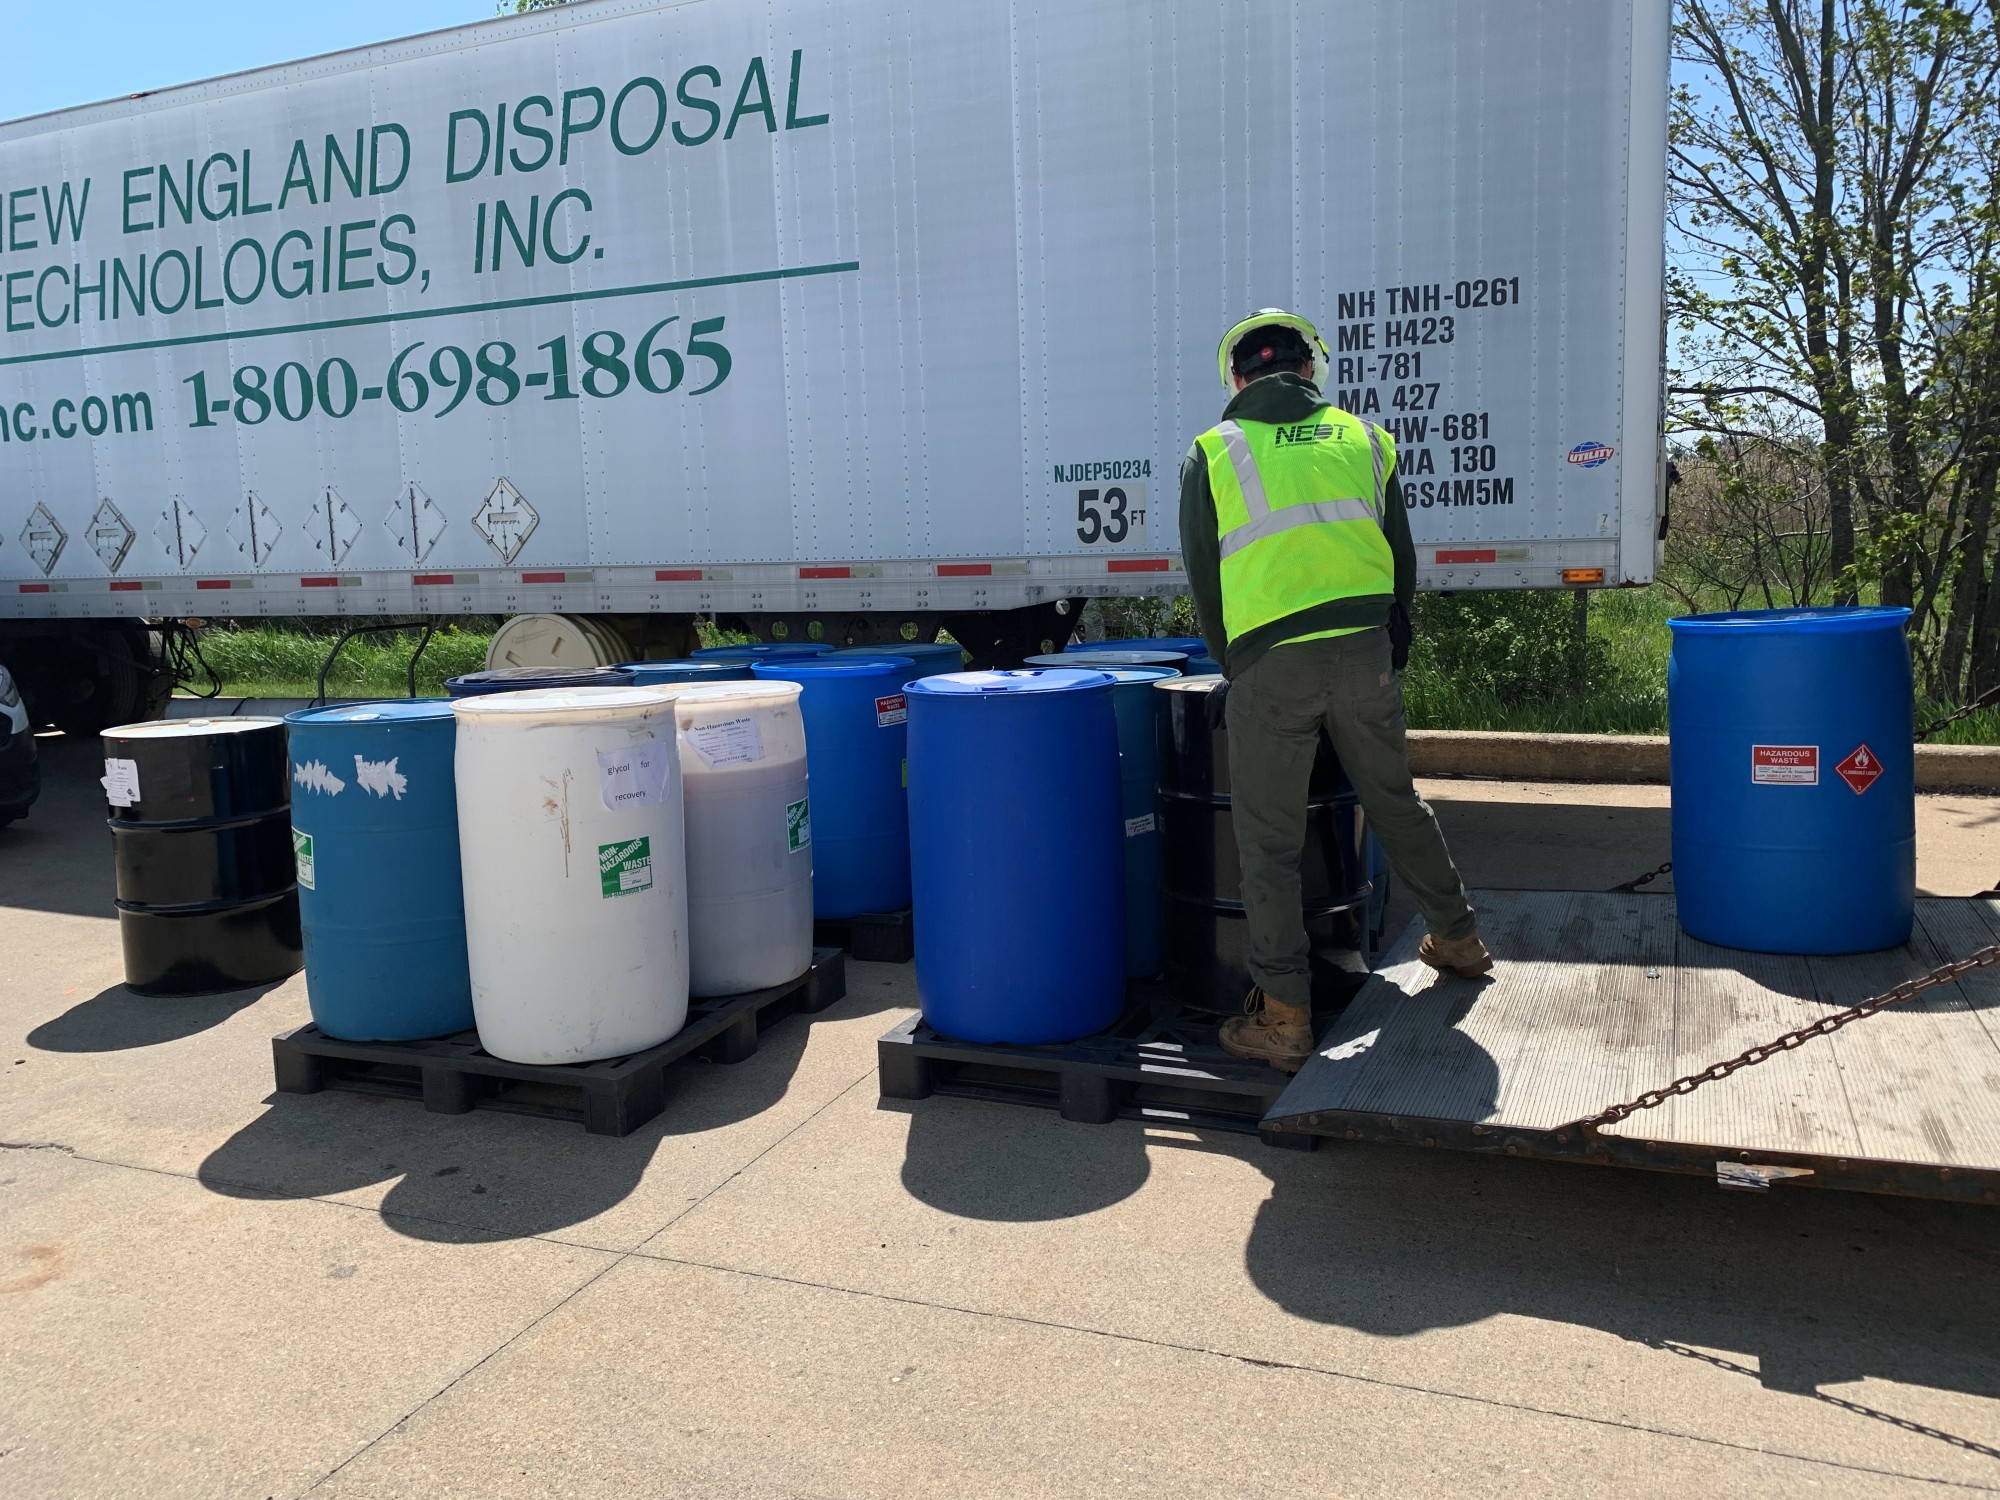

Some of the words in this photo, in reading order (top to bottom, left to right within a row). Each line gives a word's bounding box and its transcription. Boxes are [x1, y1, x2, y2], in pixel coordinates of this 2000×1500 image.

[0, 178, 91, 254] EW
[122, 122, 411, 234] ENGLAND
[446, 49, 830, 183] DISPOSAL
[0, 213, 431, 332] ECHNOLOGIES,
[474, 188, 605, 274] INC.
[1338, 290, 1376, 320] NH
[1386, 277, 1519, 315] TNH-0261
[1338, 323, 1376, 352] ME
[1386, 316, 1455, 348] H423
[182, 315, 733, 428] 1-800-698-1865
[1338, 352, 1421, 384] RI-781
[1338, 387, 1381, 415] MA
[1392, 383, 1441, 412] 427
[1054, 459, 1152, 483] NJDEP50234
[1451, 445, 1496, 473] 130
[1569, 448, 1614, 463] UTILITY
[1403, 477, 1514, 509] 6S4M5M
[1076, 487, 1129, 544] 53
[1130, 510, 1146, 525] FT
[607, 763, 630, 775] glycol
[640, 760, 650, 768] for
[615, 790, 647, 802] recovery
[600, 846, 619, 862] NON-
[600, 838, 643, 873] HAZARDOUS
[622, 856, 651, 871] WASTE
